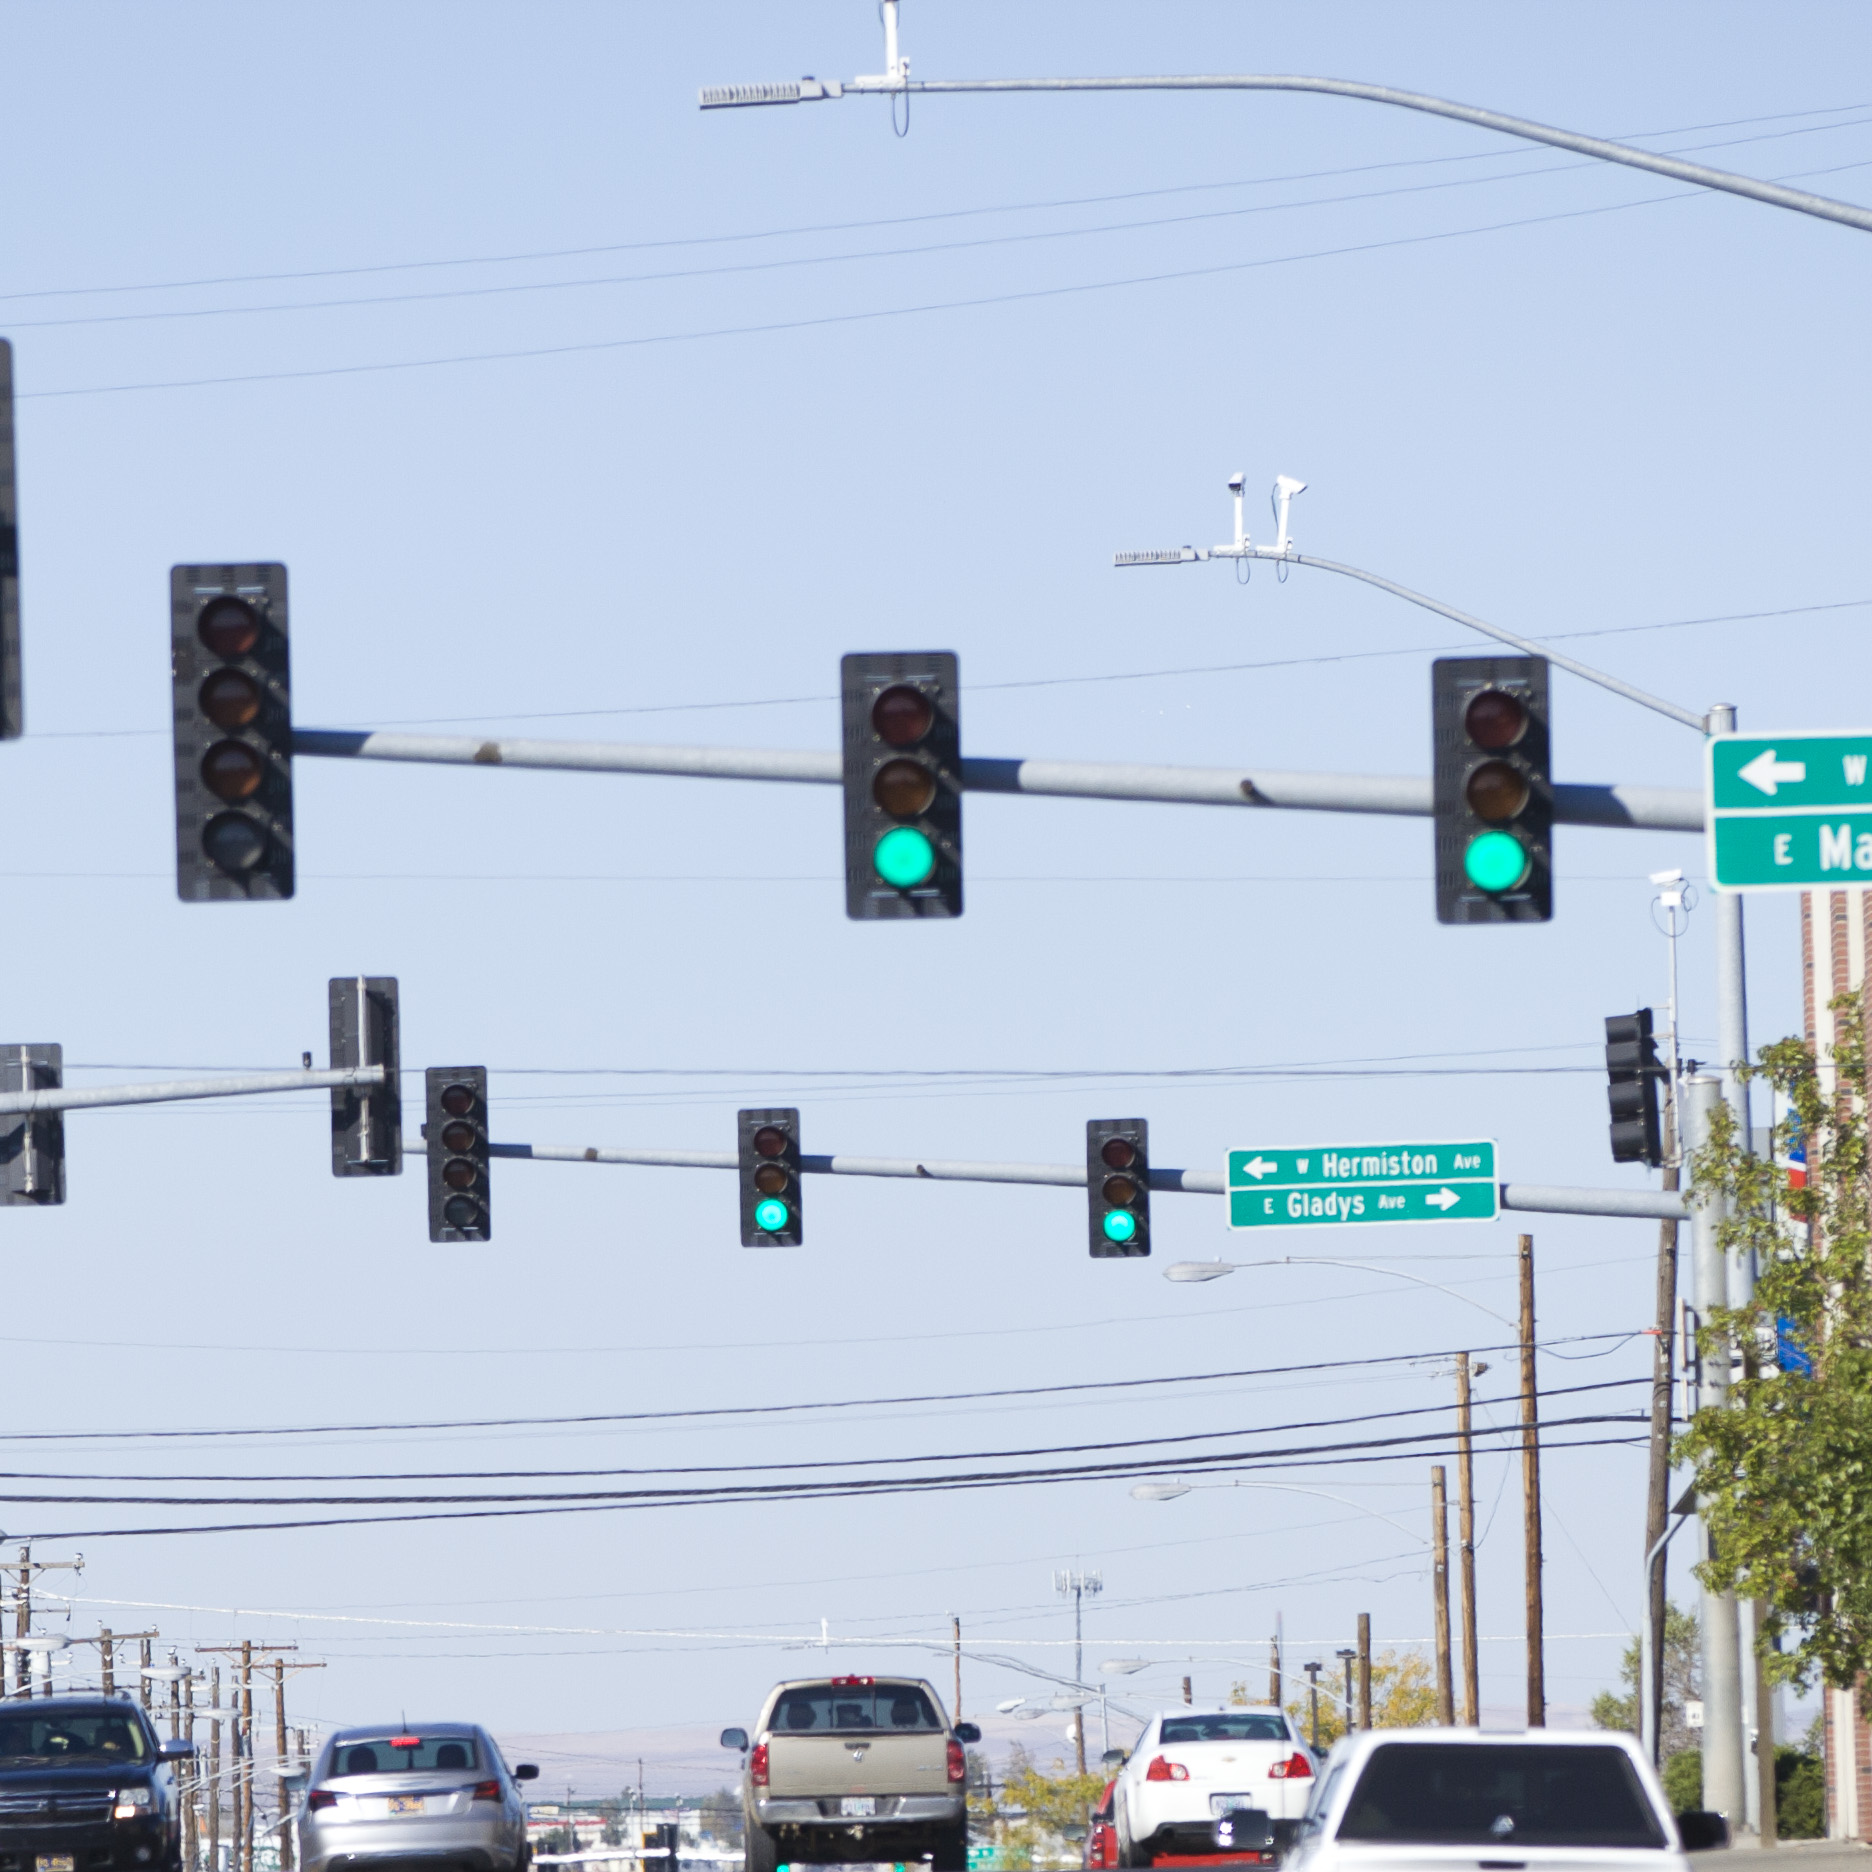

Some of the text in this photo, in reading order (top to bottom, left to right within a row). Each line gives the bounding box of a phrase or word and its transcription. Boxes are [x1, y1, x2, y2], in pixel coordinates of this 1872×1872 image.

[1842, 754, 1868, 786] W
[1774, 833, 1793, 865] E
[1296, 1150, 1481, 1178] W Hermiston Ave
[1264, 1191, 1406, 1221] E Gladys Ave
